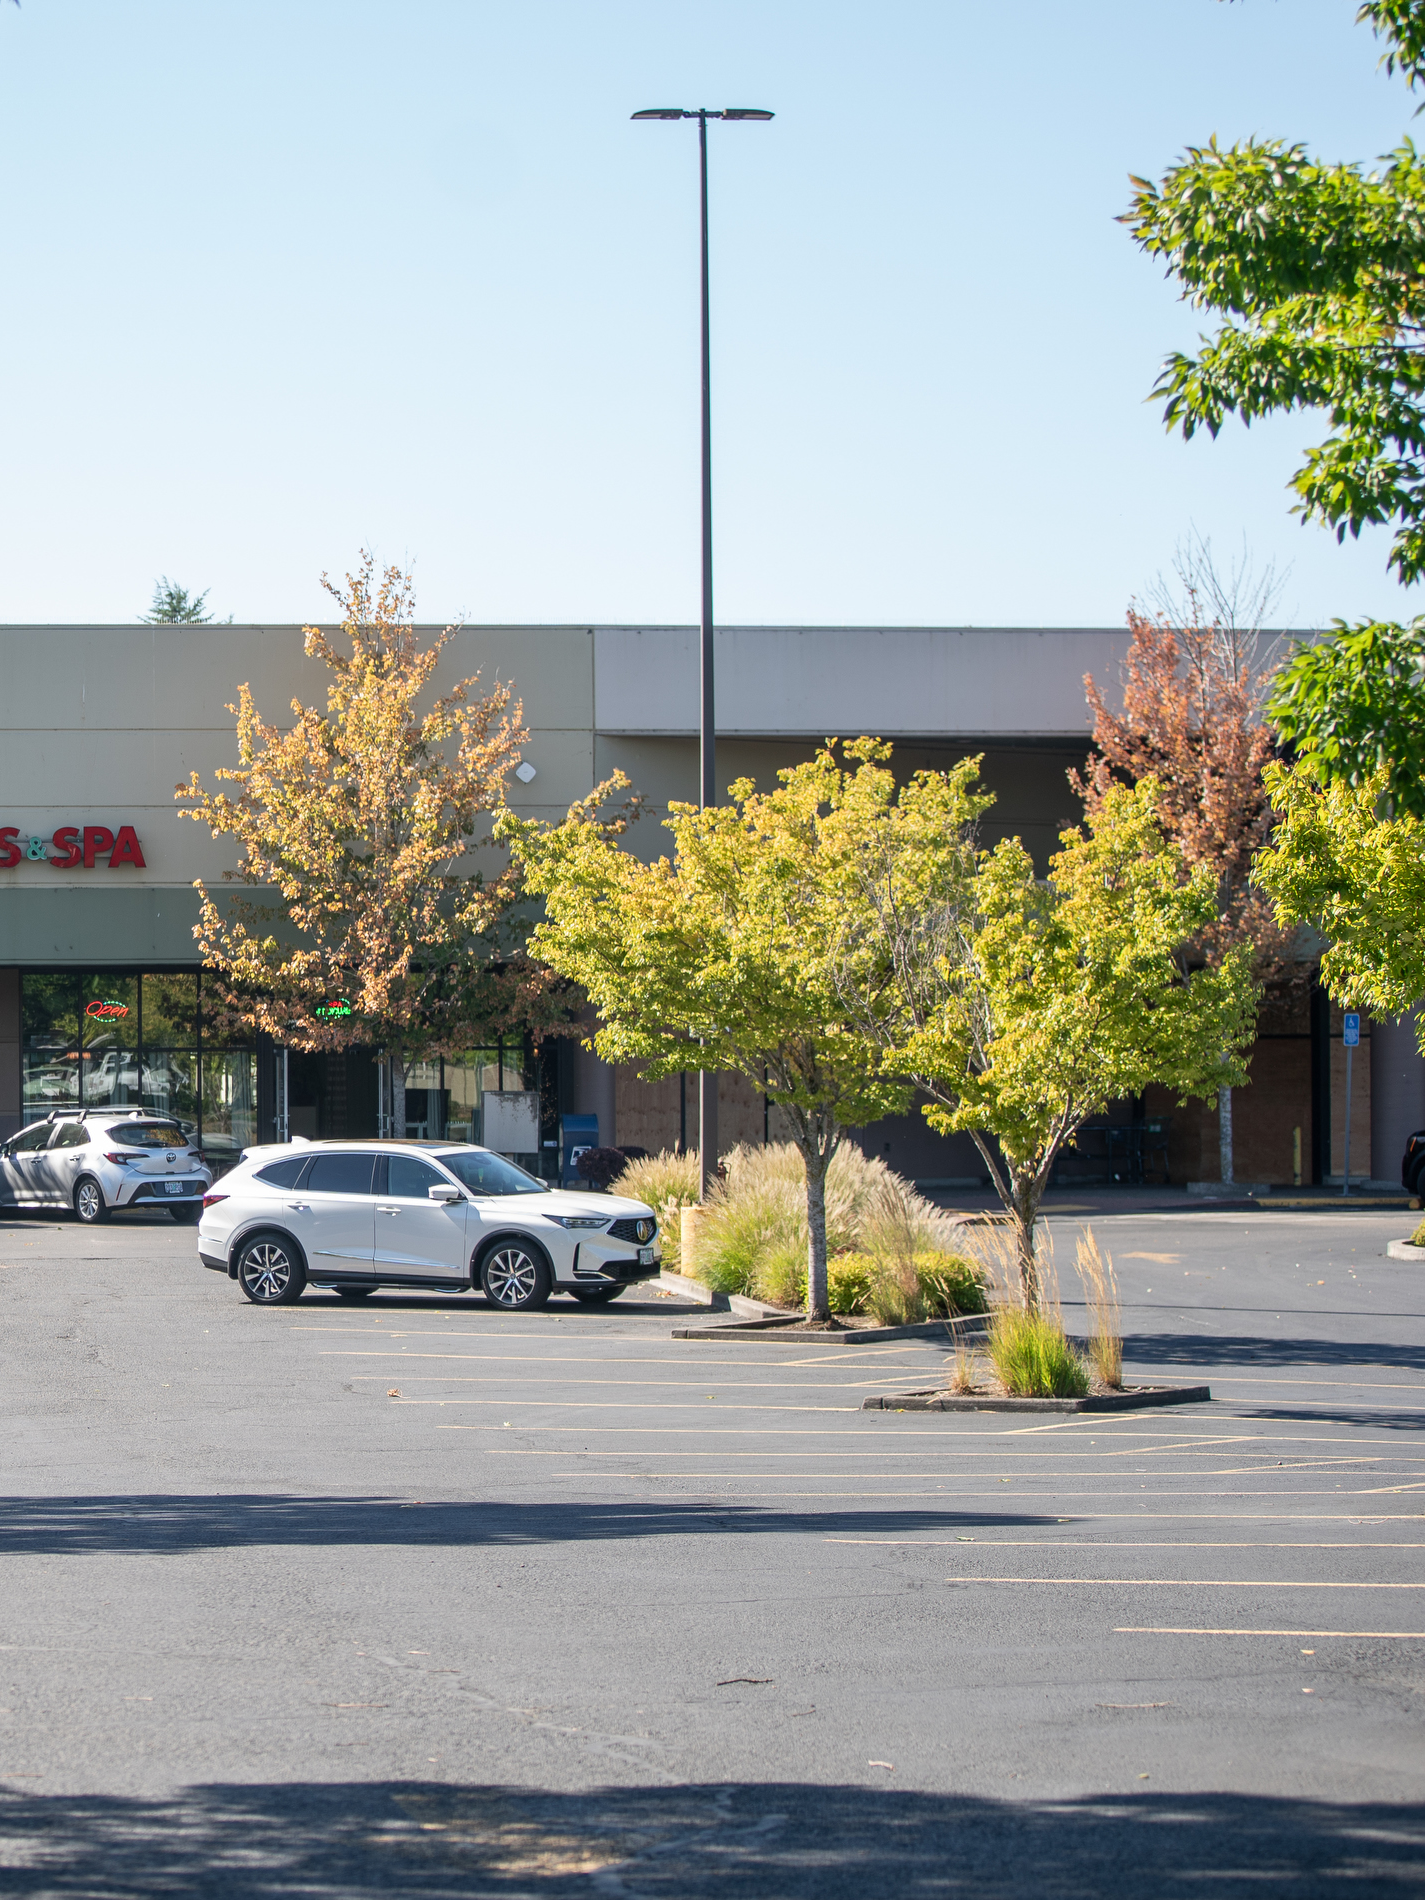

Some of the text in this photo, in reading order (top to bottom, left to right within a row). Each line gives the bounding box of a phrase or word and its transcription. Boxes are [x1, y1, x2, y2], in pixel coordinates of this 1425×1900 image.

[26, 836, 47, 861] &
[50, 825, 147, 869] SPA
[86, 1000, 129, 1018] Open
